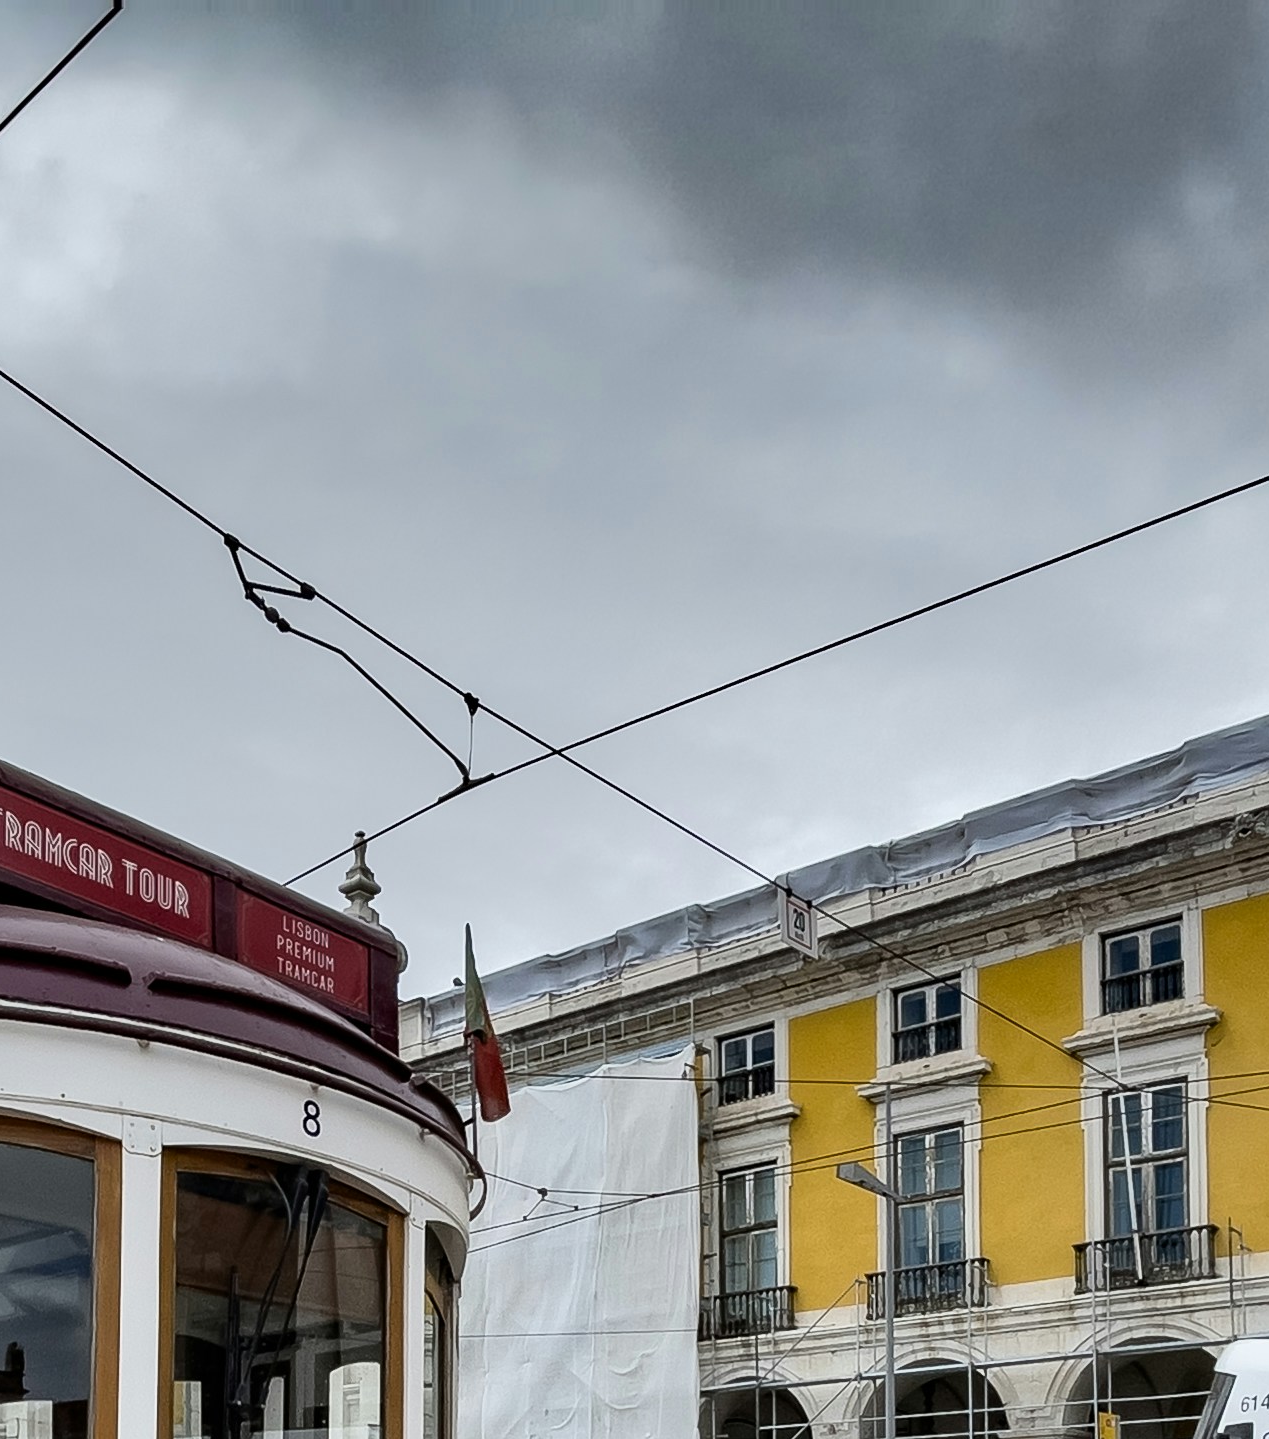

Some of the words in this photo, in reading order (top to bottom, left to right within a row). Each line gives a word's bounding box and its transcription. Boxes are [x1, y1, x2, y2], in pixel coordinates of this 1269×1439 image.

[122, 858, 190, 919] TOUR
[283, 915, 329, 949] LISBON
[276, 934, 334, 972] PREMIUM
[276, 956, 334, 994] TRAMCAR
[302, 1099, 321, 1138] 8
